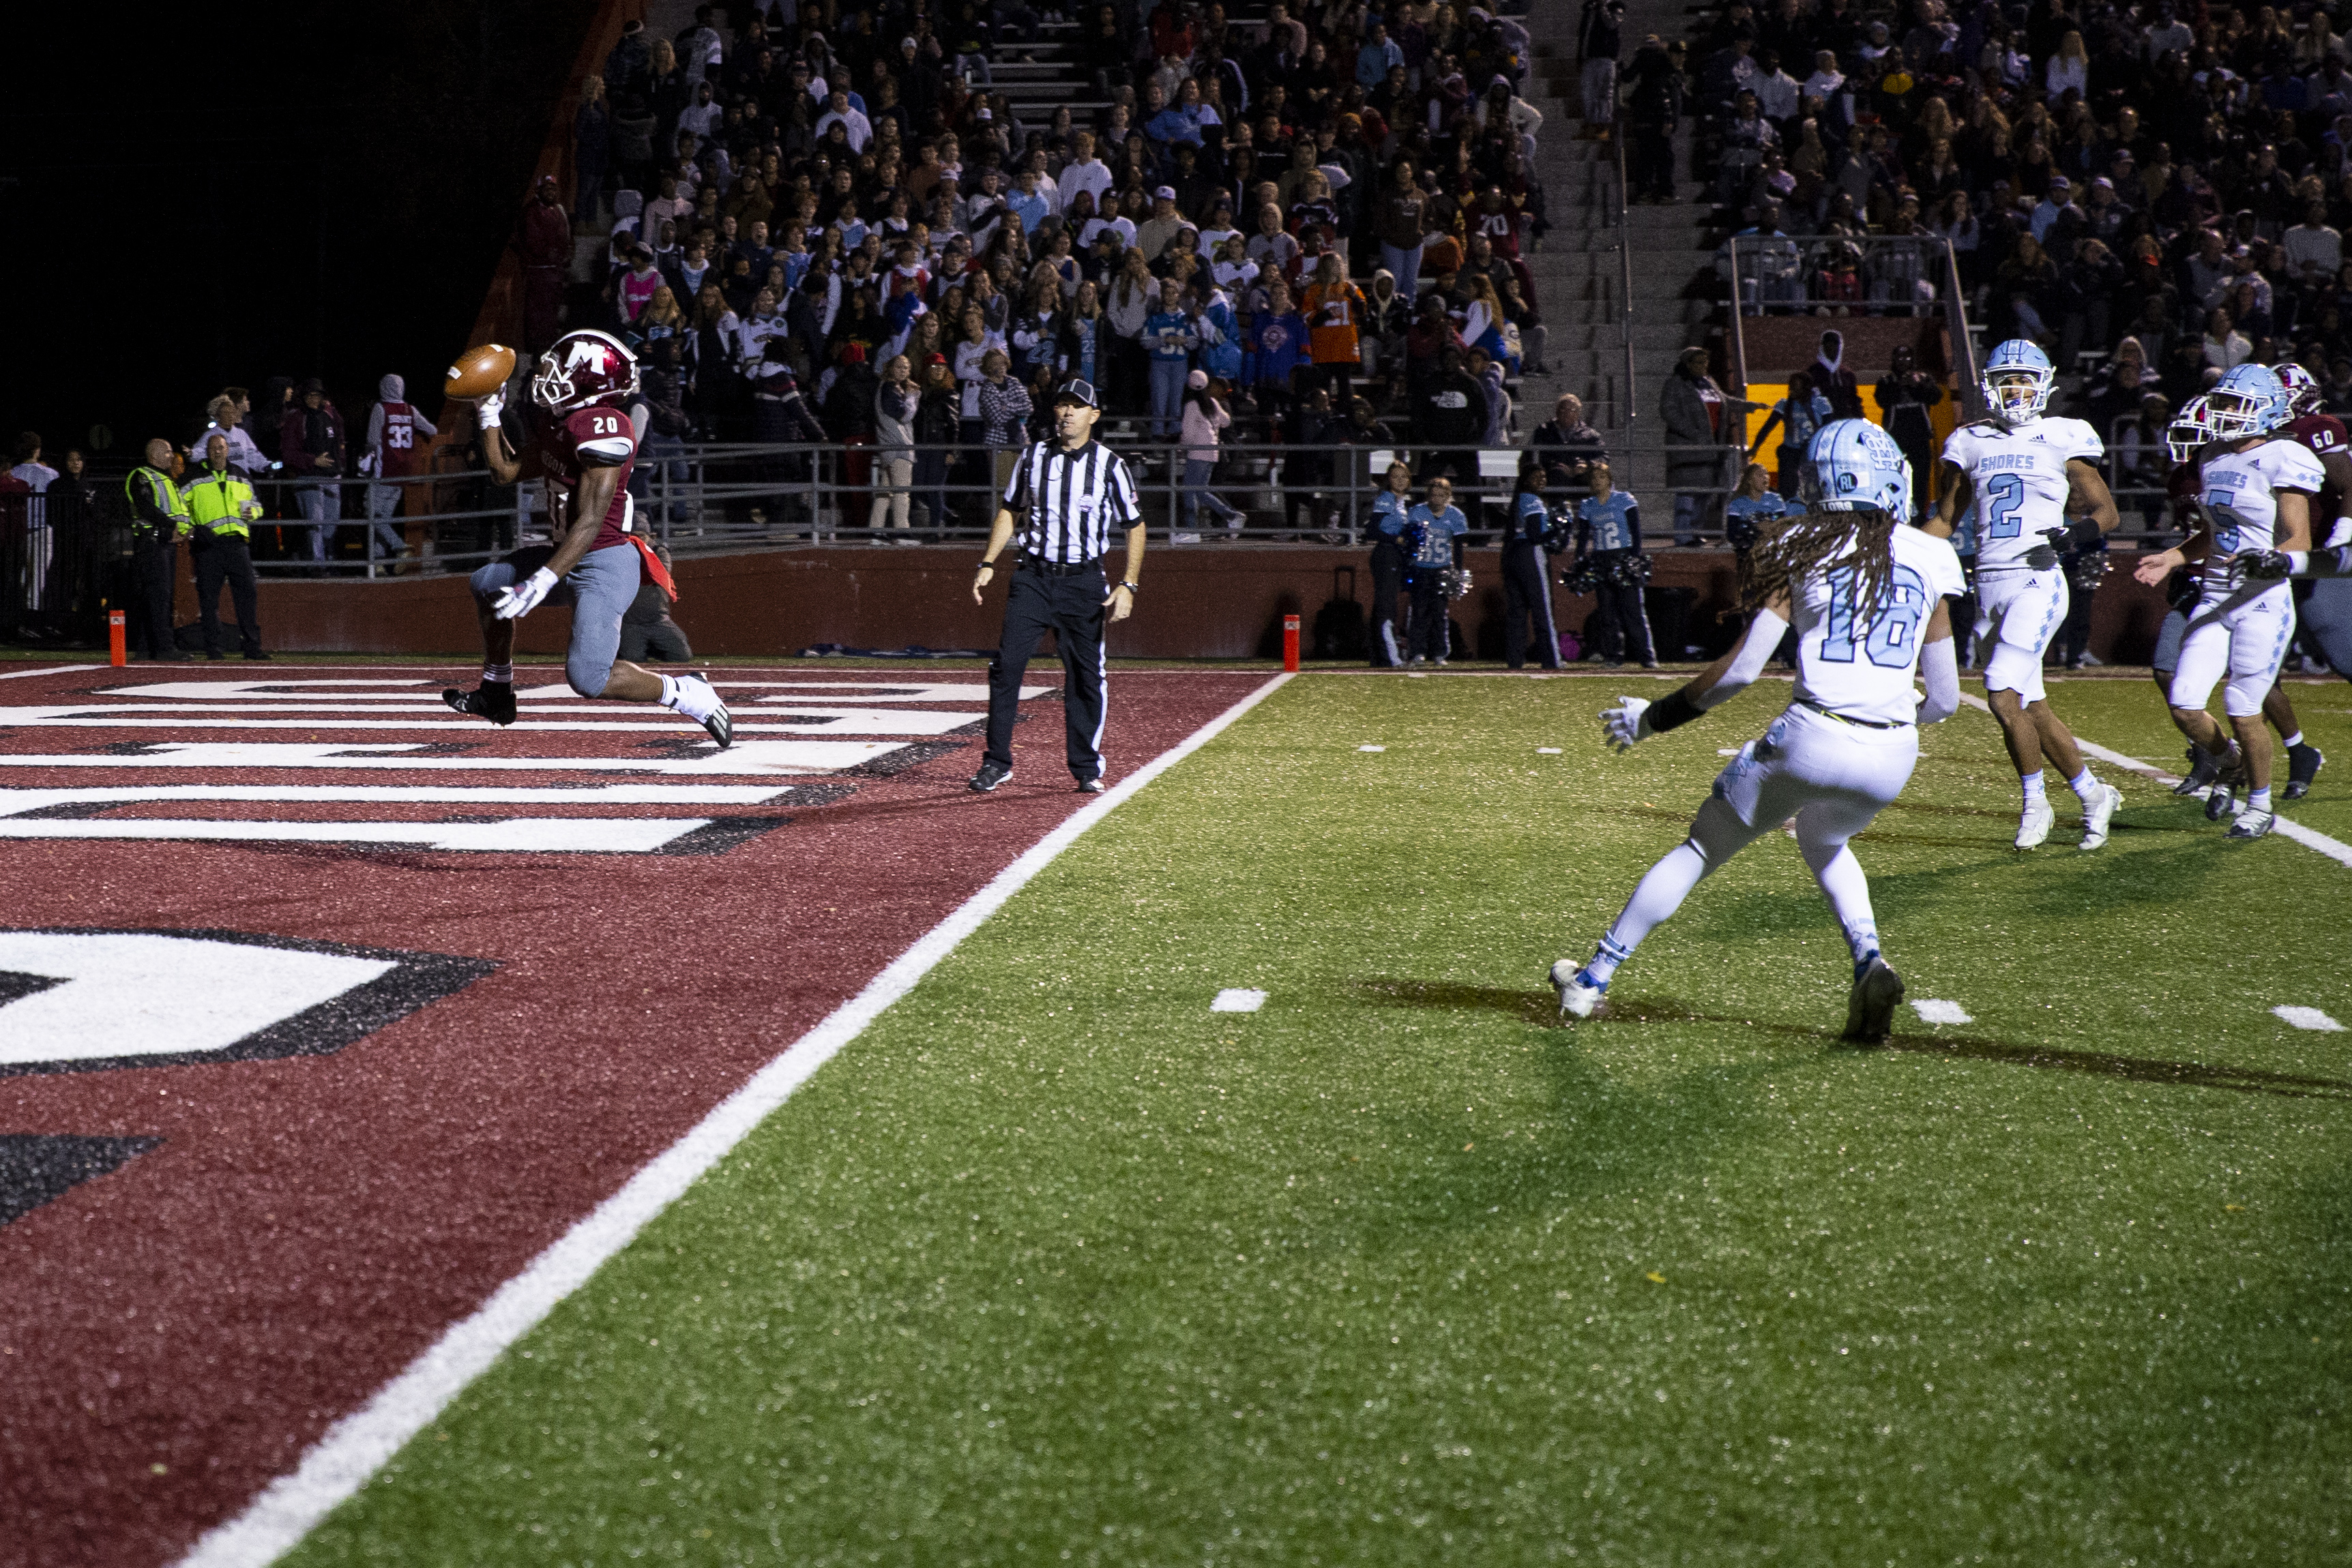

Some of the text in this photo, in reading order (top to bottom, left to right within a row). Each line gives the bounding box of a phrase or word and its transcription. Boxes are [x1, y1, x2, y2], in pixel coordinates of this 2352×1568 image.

[563, 341, 604, 375] M
[1025, 340, 1054, 365] 22
[388, 426, 412, 448] 33
[593, 417, 618, 434] 20
[2312, 430, 2334, 449] 60
[1980, 454, 2034, 473] SHORES
[2207, 471, 2248, 489] SHORES
[1987, 473, 2023, 538] 2
[2207, 489, 2239, 552] 5
[1595, 522, 1622, 550] 12
[1819, 562, 1924, 669] 18
